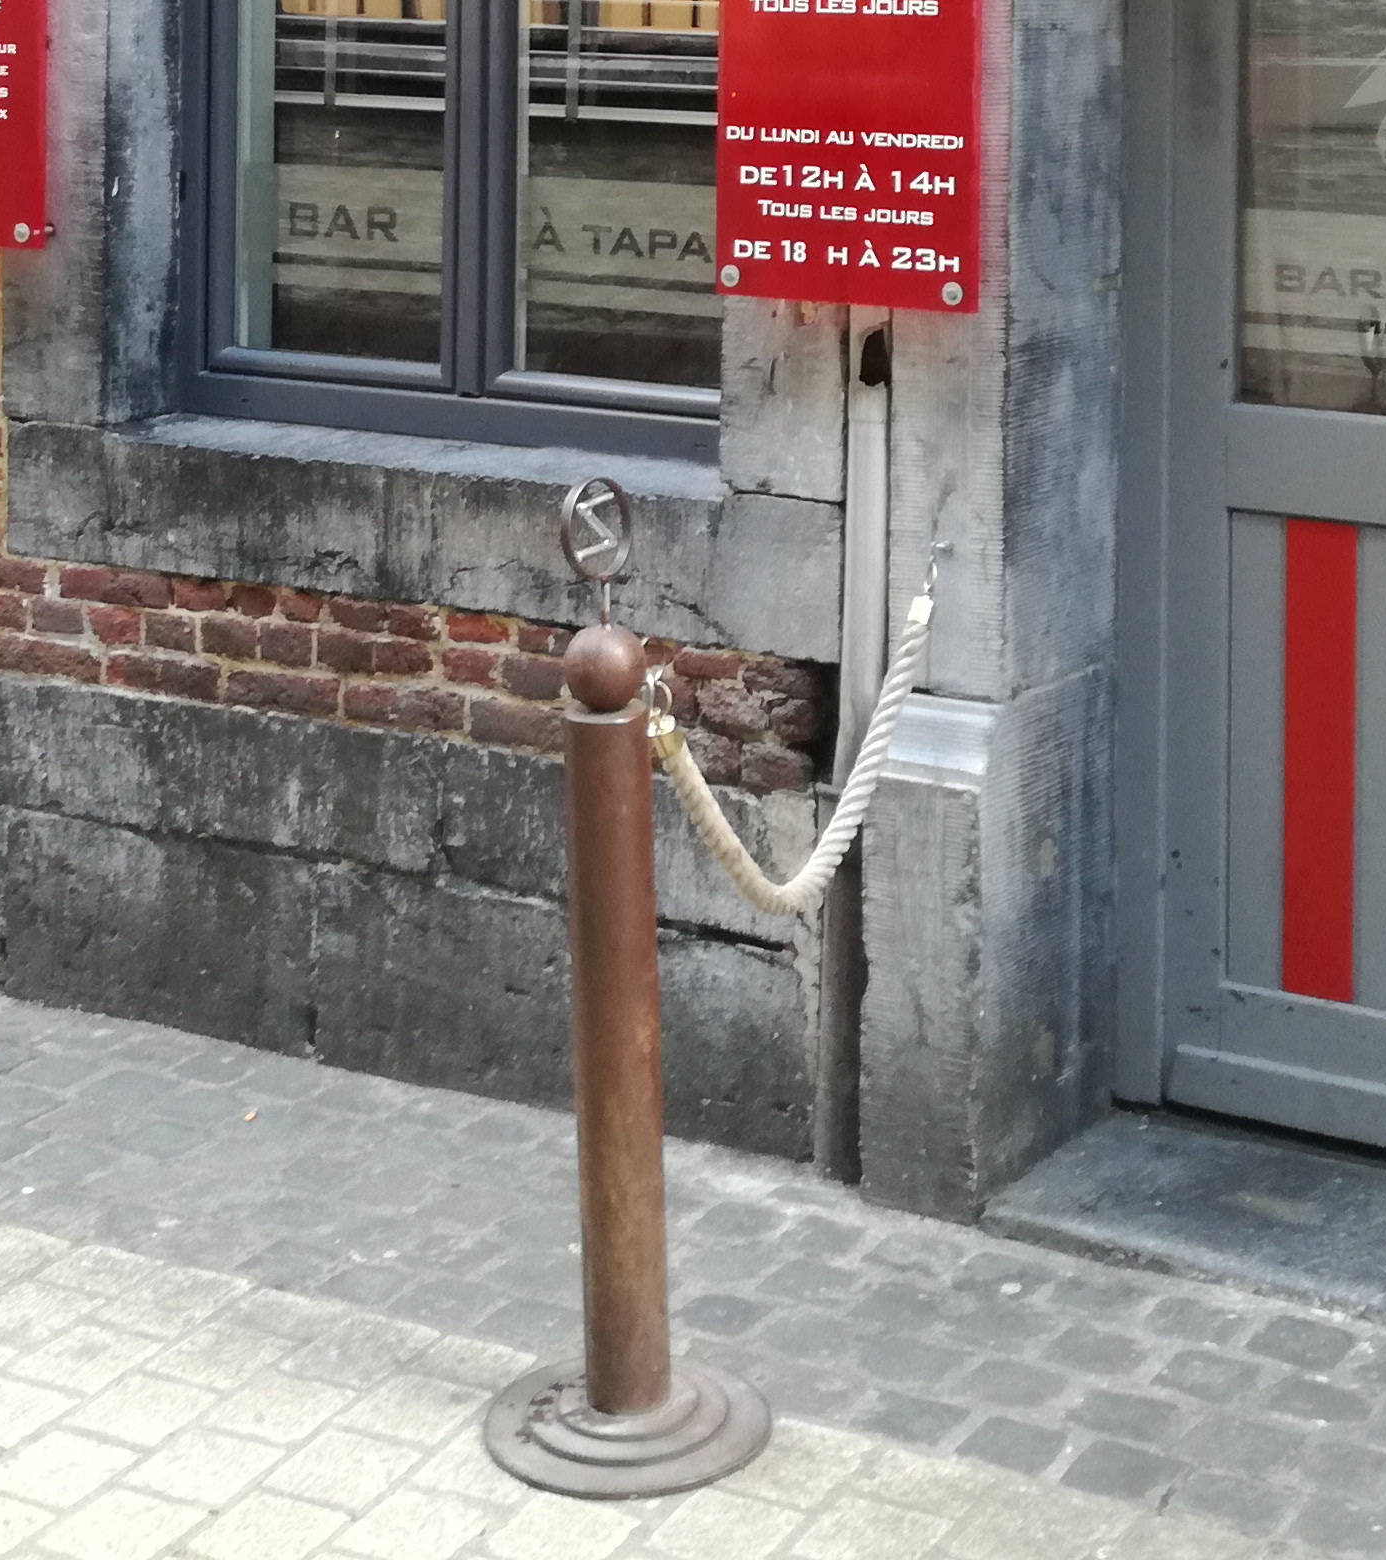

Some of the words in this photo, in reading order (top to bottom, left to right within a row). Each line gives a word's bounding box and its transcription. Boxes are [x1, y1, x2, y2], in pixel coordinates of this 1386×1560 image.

[725, 125, 755, 141] DU
[760, 127, 820, 144] LUNDI
[825, 130, 854, 146] AU
[860, 131, 964, 150] VENDREDI
[853, 164, 876, 192] À
[891, 170, 955, 196] 14H
[288, 201, 399, 243] BAR
[531, 207, 566, 253] À
[757, 199, 813, 219] TOUS
[819, 205, 858, 221] LES
[863, 208, 934, 226] JOURS
[733, 239, 772, 260] DE
[780, 239, 807, 263] 18
[858, 241, 881, 268] À
[891, 246, 960, 273] 23H
[1274, 263, 1384, 300] BAR
